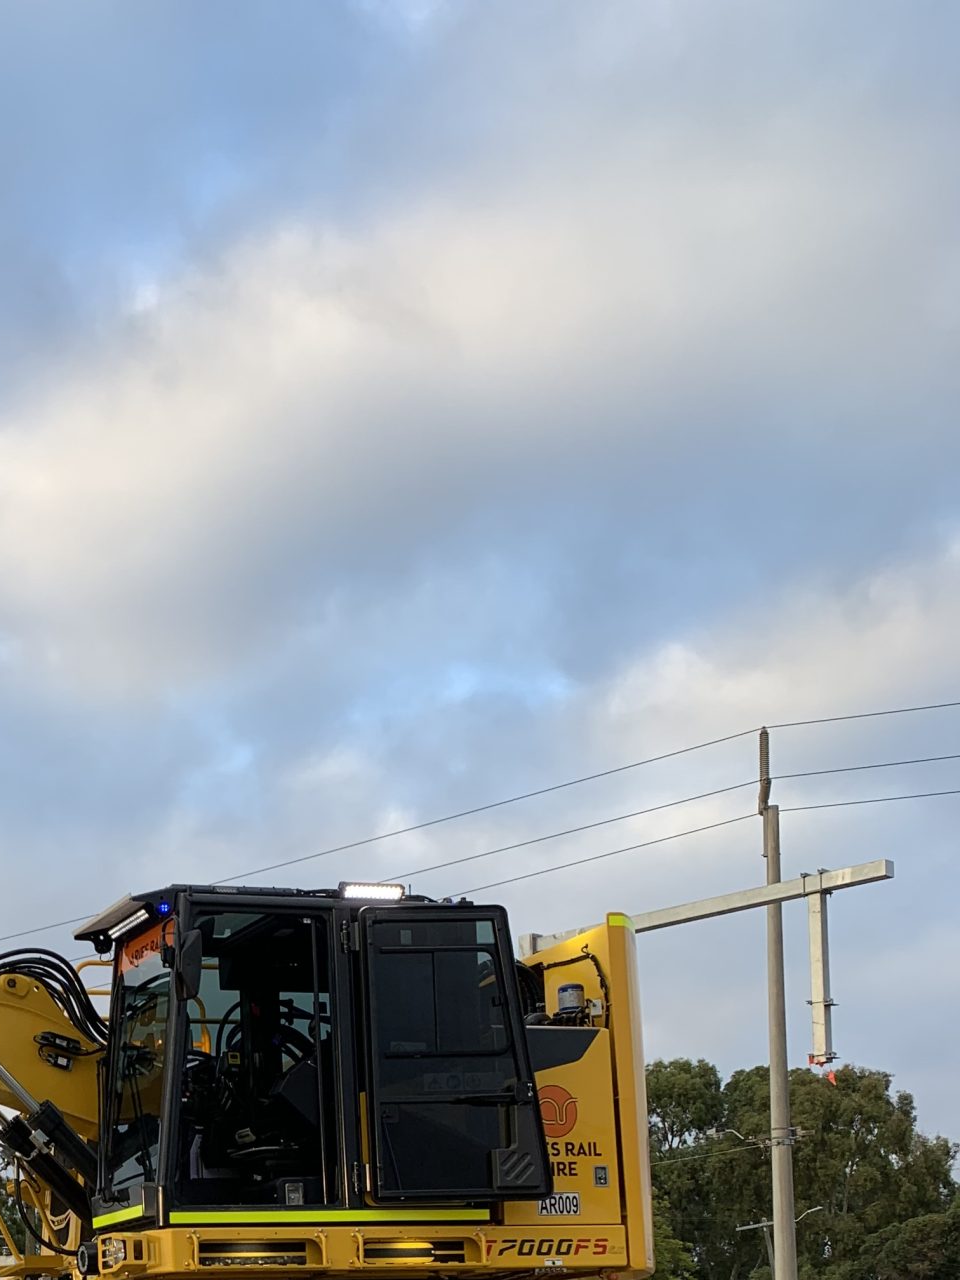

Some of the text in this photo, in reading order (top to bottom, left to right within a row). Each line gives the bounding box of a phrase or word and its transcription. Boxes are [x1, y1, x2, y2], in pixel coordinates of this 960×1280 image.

[565, 1142, 602, 1157] RAIL
[540, 1195, 579, 1215] AR009
[485, 1238, 609, 1257] T7000FS
